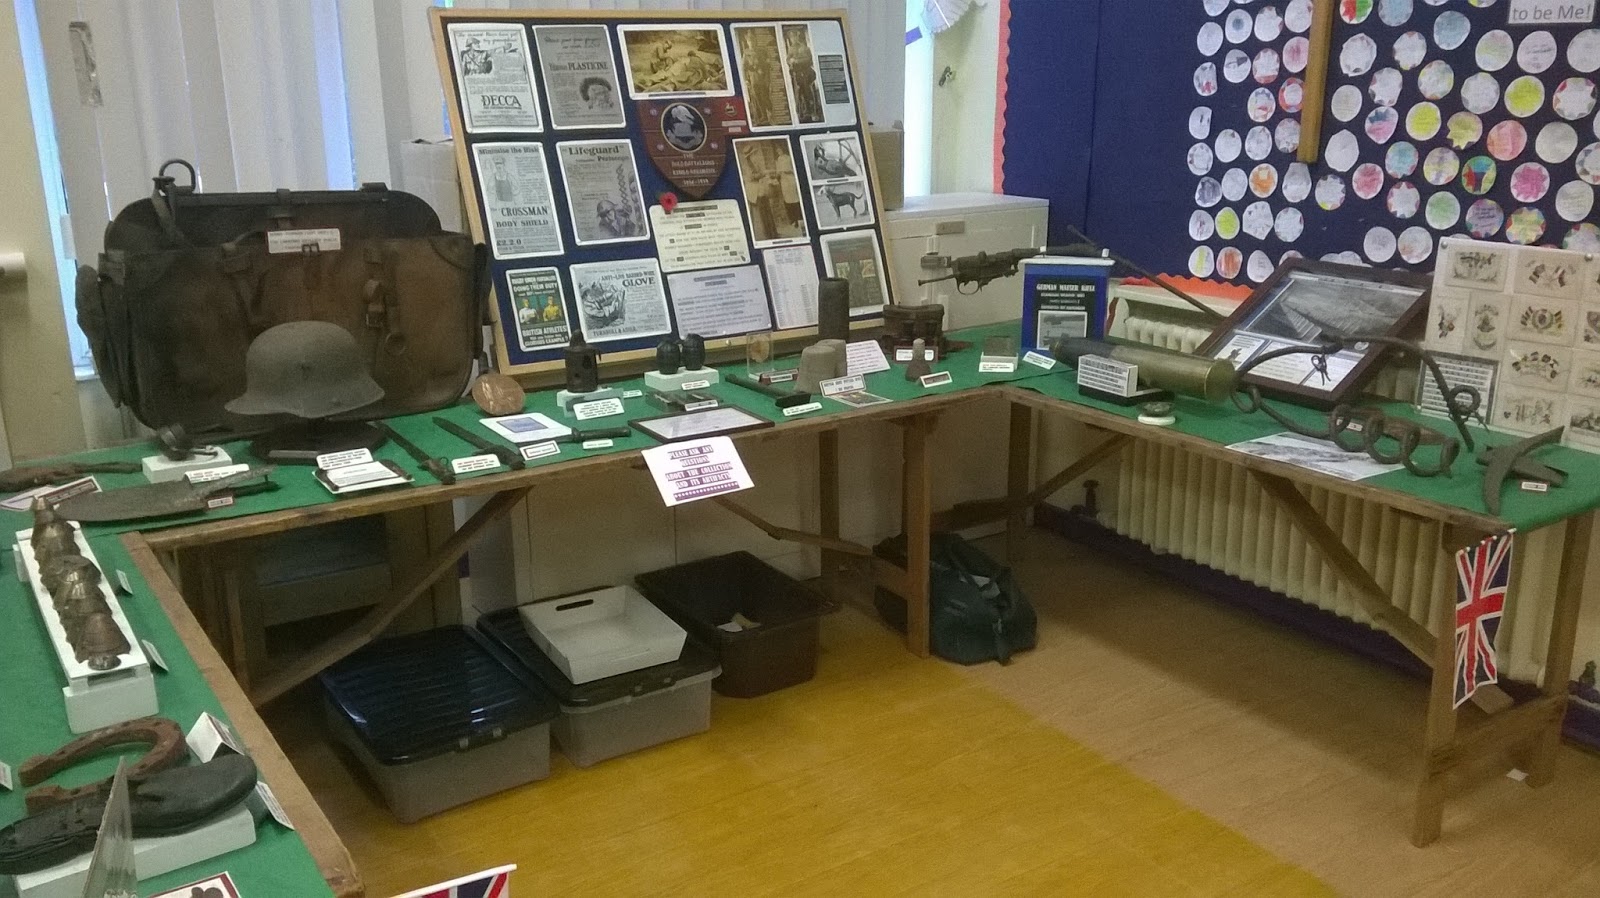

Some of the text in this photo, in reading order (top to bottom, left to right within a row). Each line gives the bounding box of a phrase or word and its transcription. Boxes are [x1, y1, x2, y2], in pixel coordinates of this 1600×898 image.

[1512, 4, 1591, 20] to be Me!
[481, 94, 522, 107] DECCA
[501, 206, 548, 217] CROSSMAN
[496, 219, 549, 228] BODY SHIELD
[622, 277, 656, 288] GLOVE
[688, 446, 701, 456] ASK
[702, 444, 714, 454] ANY
[687, 469, 699, 477] THE
[701, 462, 733, 474] COLLECTION
